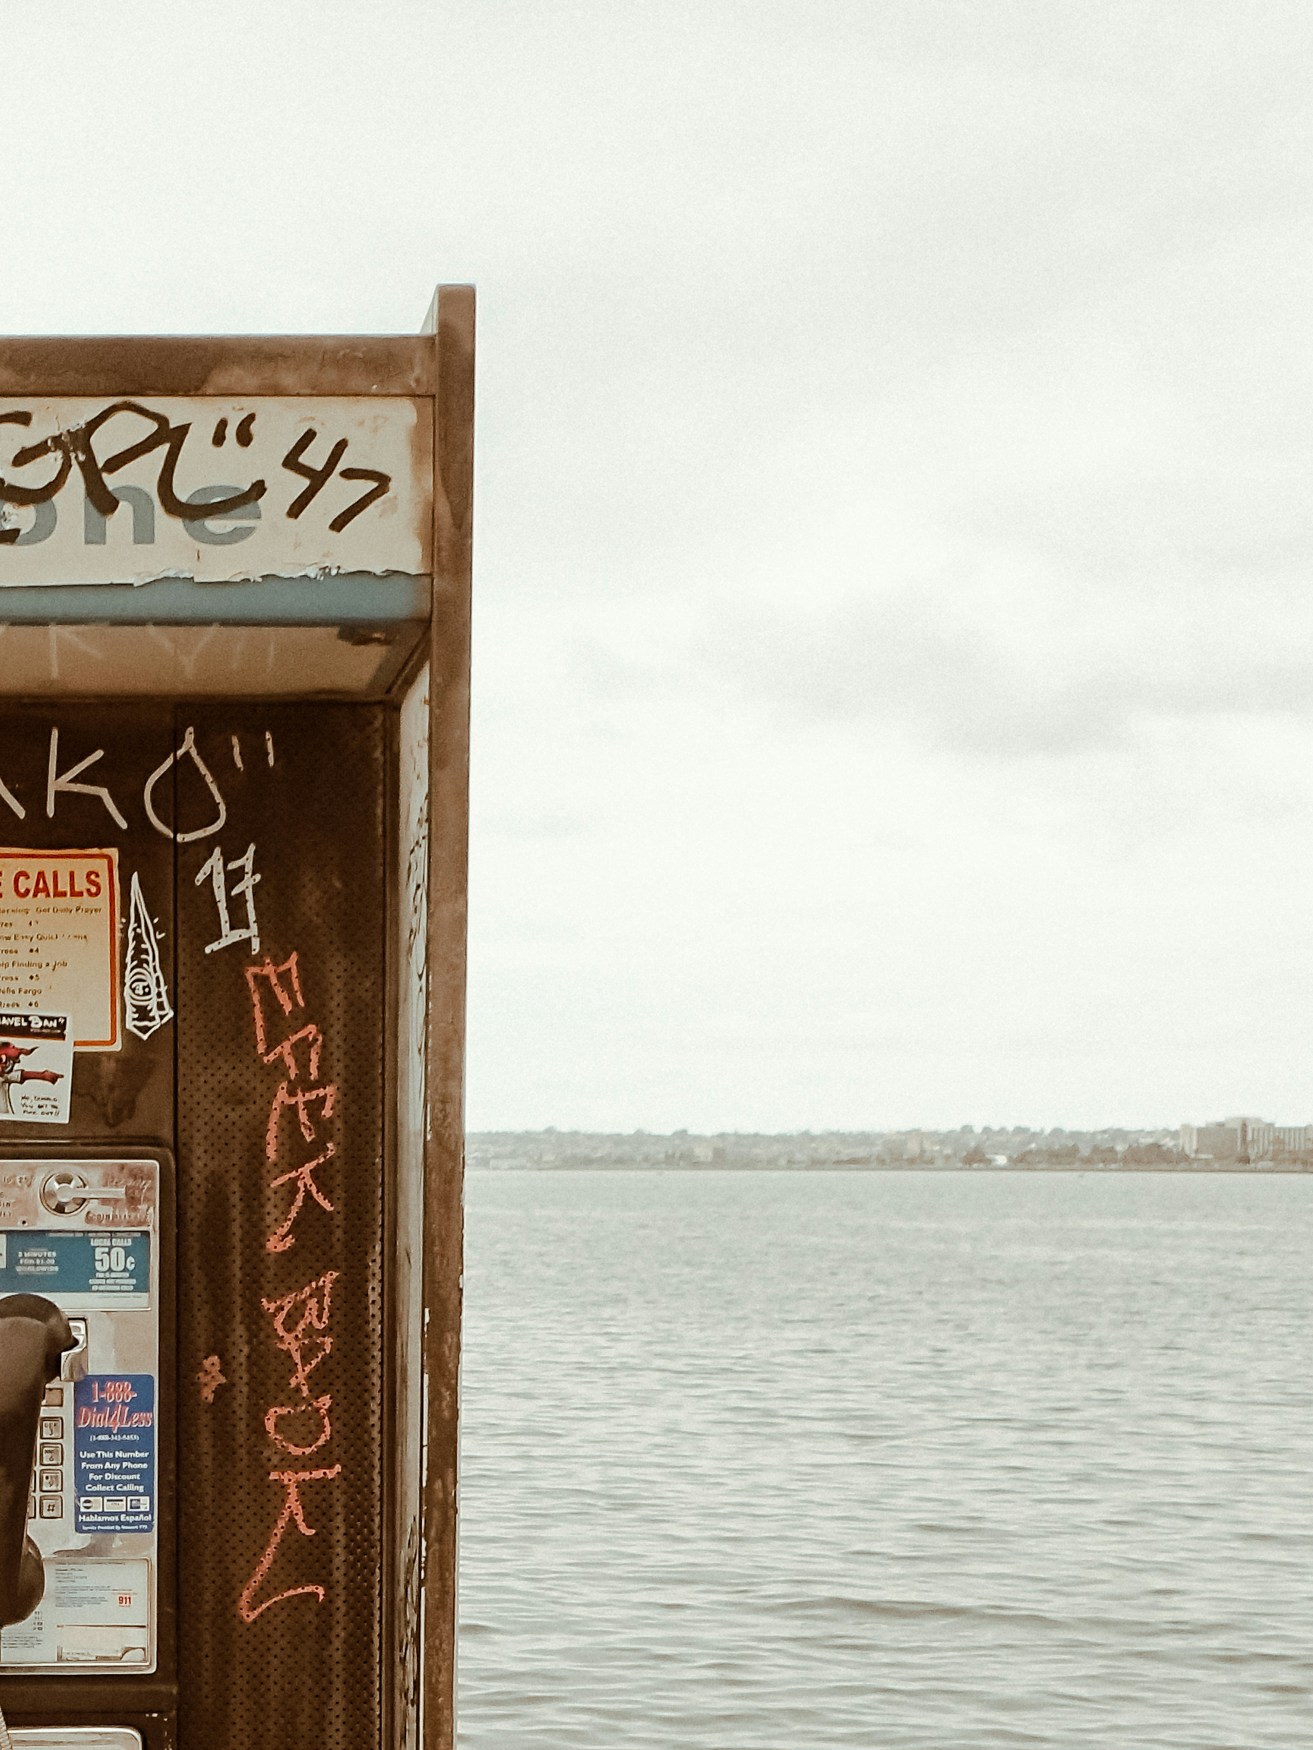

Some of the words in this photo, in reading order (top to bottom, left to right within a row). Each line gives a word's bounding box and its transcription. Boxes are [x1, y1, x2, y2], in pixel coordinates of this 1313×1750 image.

[13, 870, 102, 898] CALLS
[17, 987, 43, 996] Fargo
[96, 1450, 114, 1458] This
[114, 1450, 149, 1458] Number
[104, 1462, 121, 1471] Any
[116, 1484, 145, 1493] Calling
[79, 1514, 120, 1522] Hablamos
[120, 1513, 152, 1523] Español
[118, 1596, 132, 1605] 911
